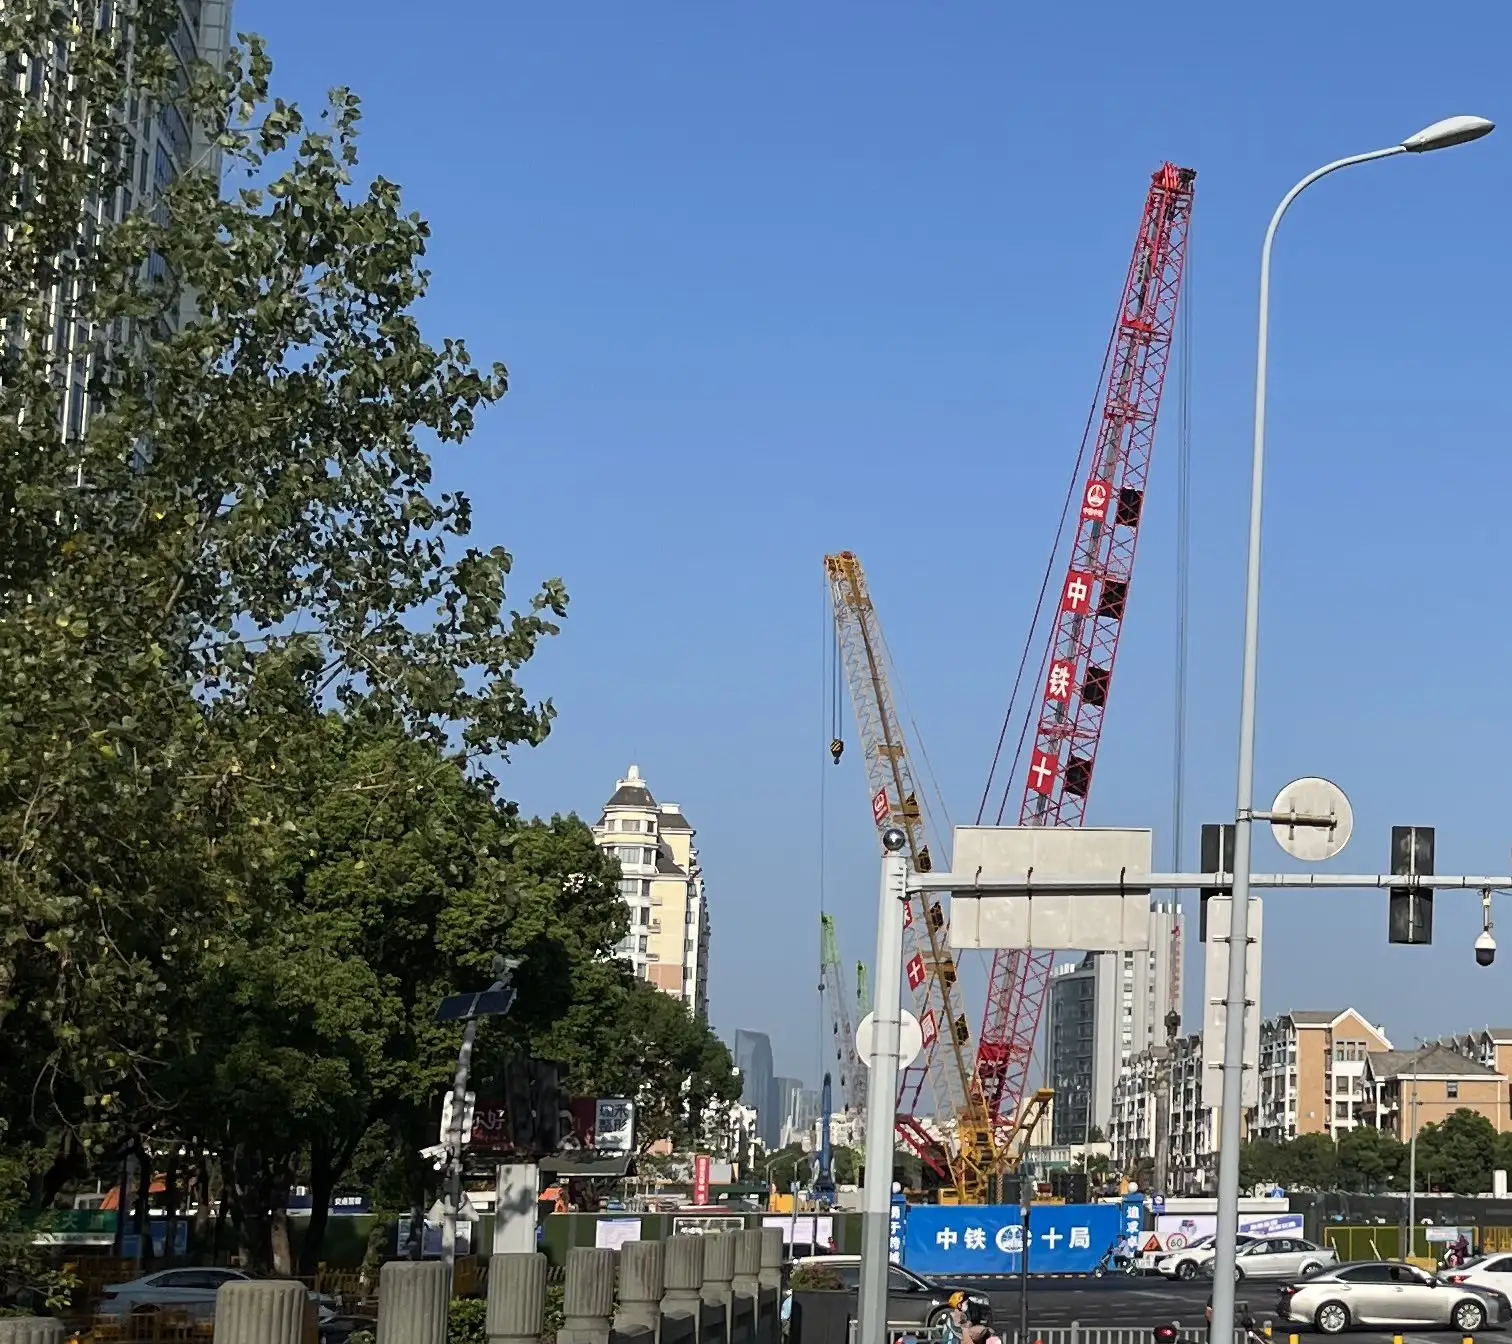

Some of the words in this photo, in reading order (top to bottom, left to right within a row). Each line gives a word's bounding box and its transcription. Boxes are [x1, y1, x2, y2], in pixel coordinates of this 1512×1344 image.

[936, 1227, 987, 1250] 中铁
[1041, 1227, 1091, 1249] 十局
[1170, 1238, 1183, 1248] 60
